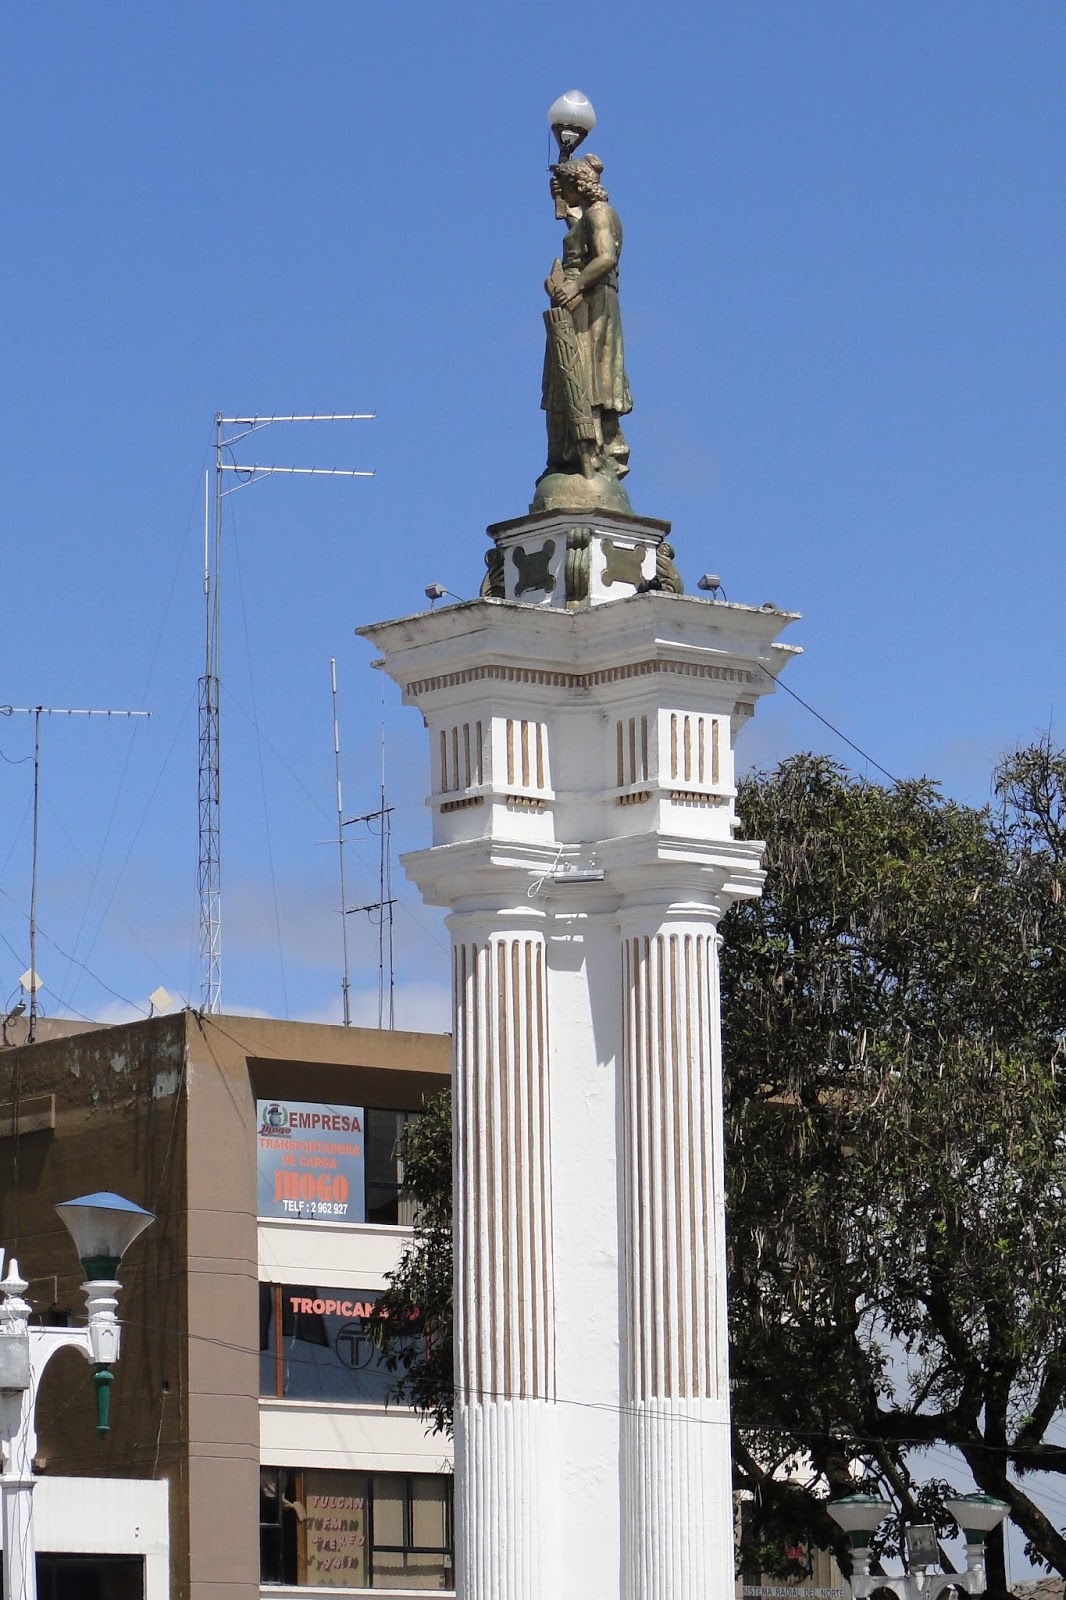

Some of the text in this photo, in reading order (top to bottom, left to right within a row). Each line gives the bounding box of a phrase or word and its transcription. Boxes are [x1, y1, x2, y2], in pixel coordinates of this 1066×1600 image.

[289, 1111, 362, 1134] EMPRESA
[259, 1138, 361, 1156] TRANSPORTADORA
[282, 1153, 338, 1169] DE CARGA
[273, 1170, 349, 1204] JHOGO
[283, 1199, 305, 1213] TELF
[311, 1201, 317, 1213] 2
[318, 1202, 333, 1214] 962
[334, 1203, 348, 1215] 927
[312, 1495, 365, 1510] TULCAN
[743, 1586, 845, 1598] SISTEMA RADIAL DEL NORTE
